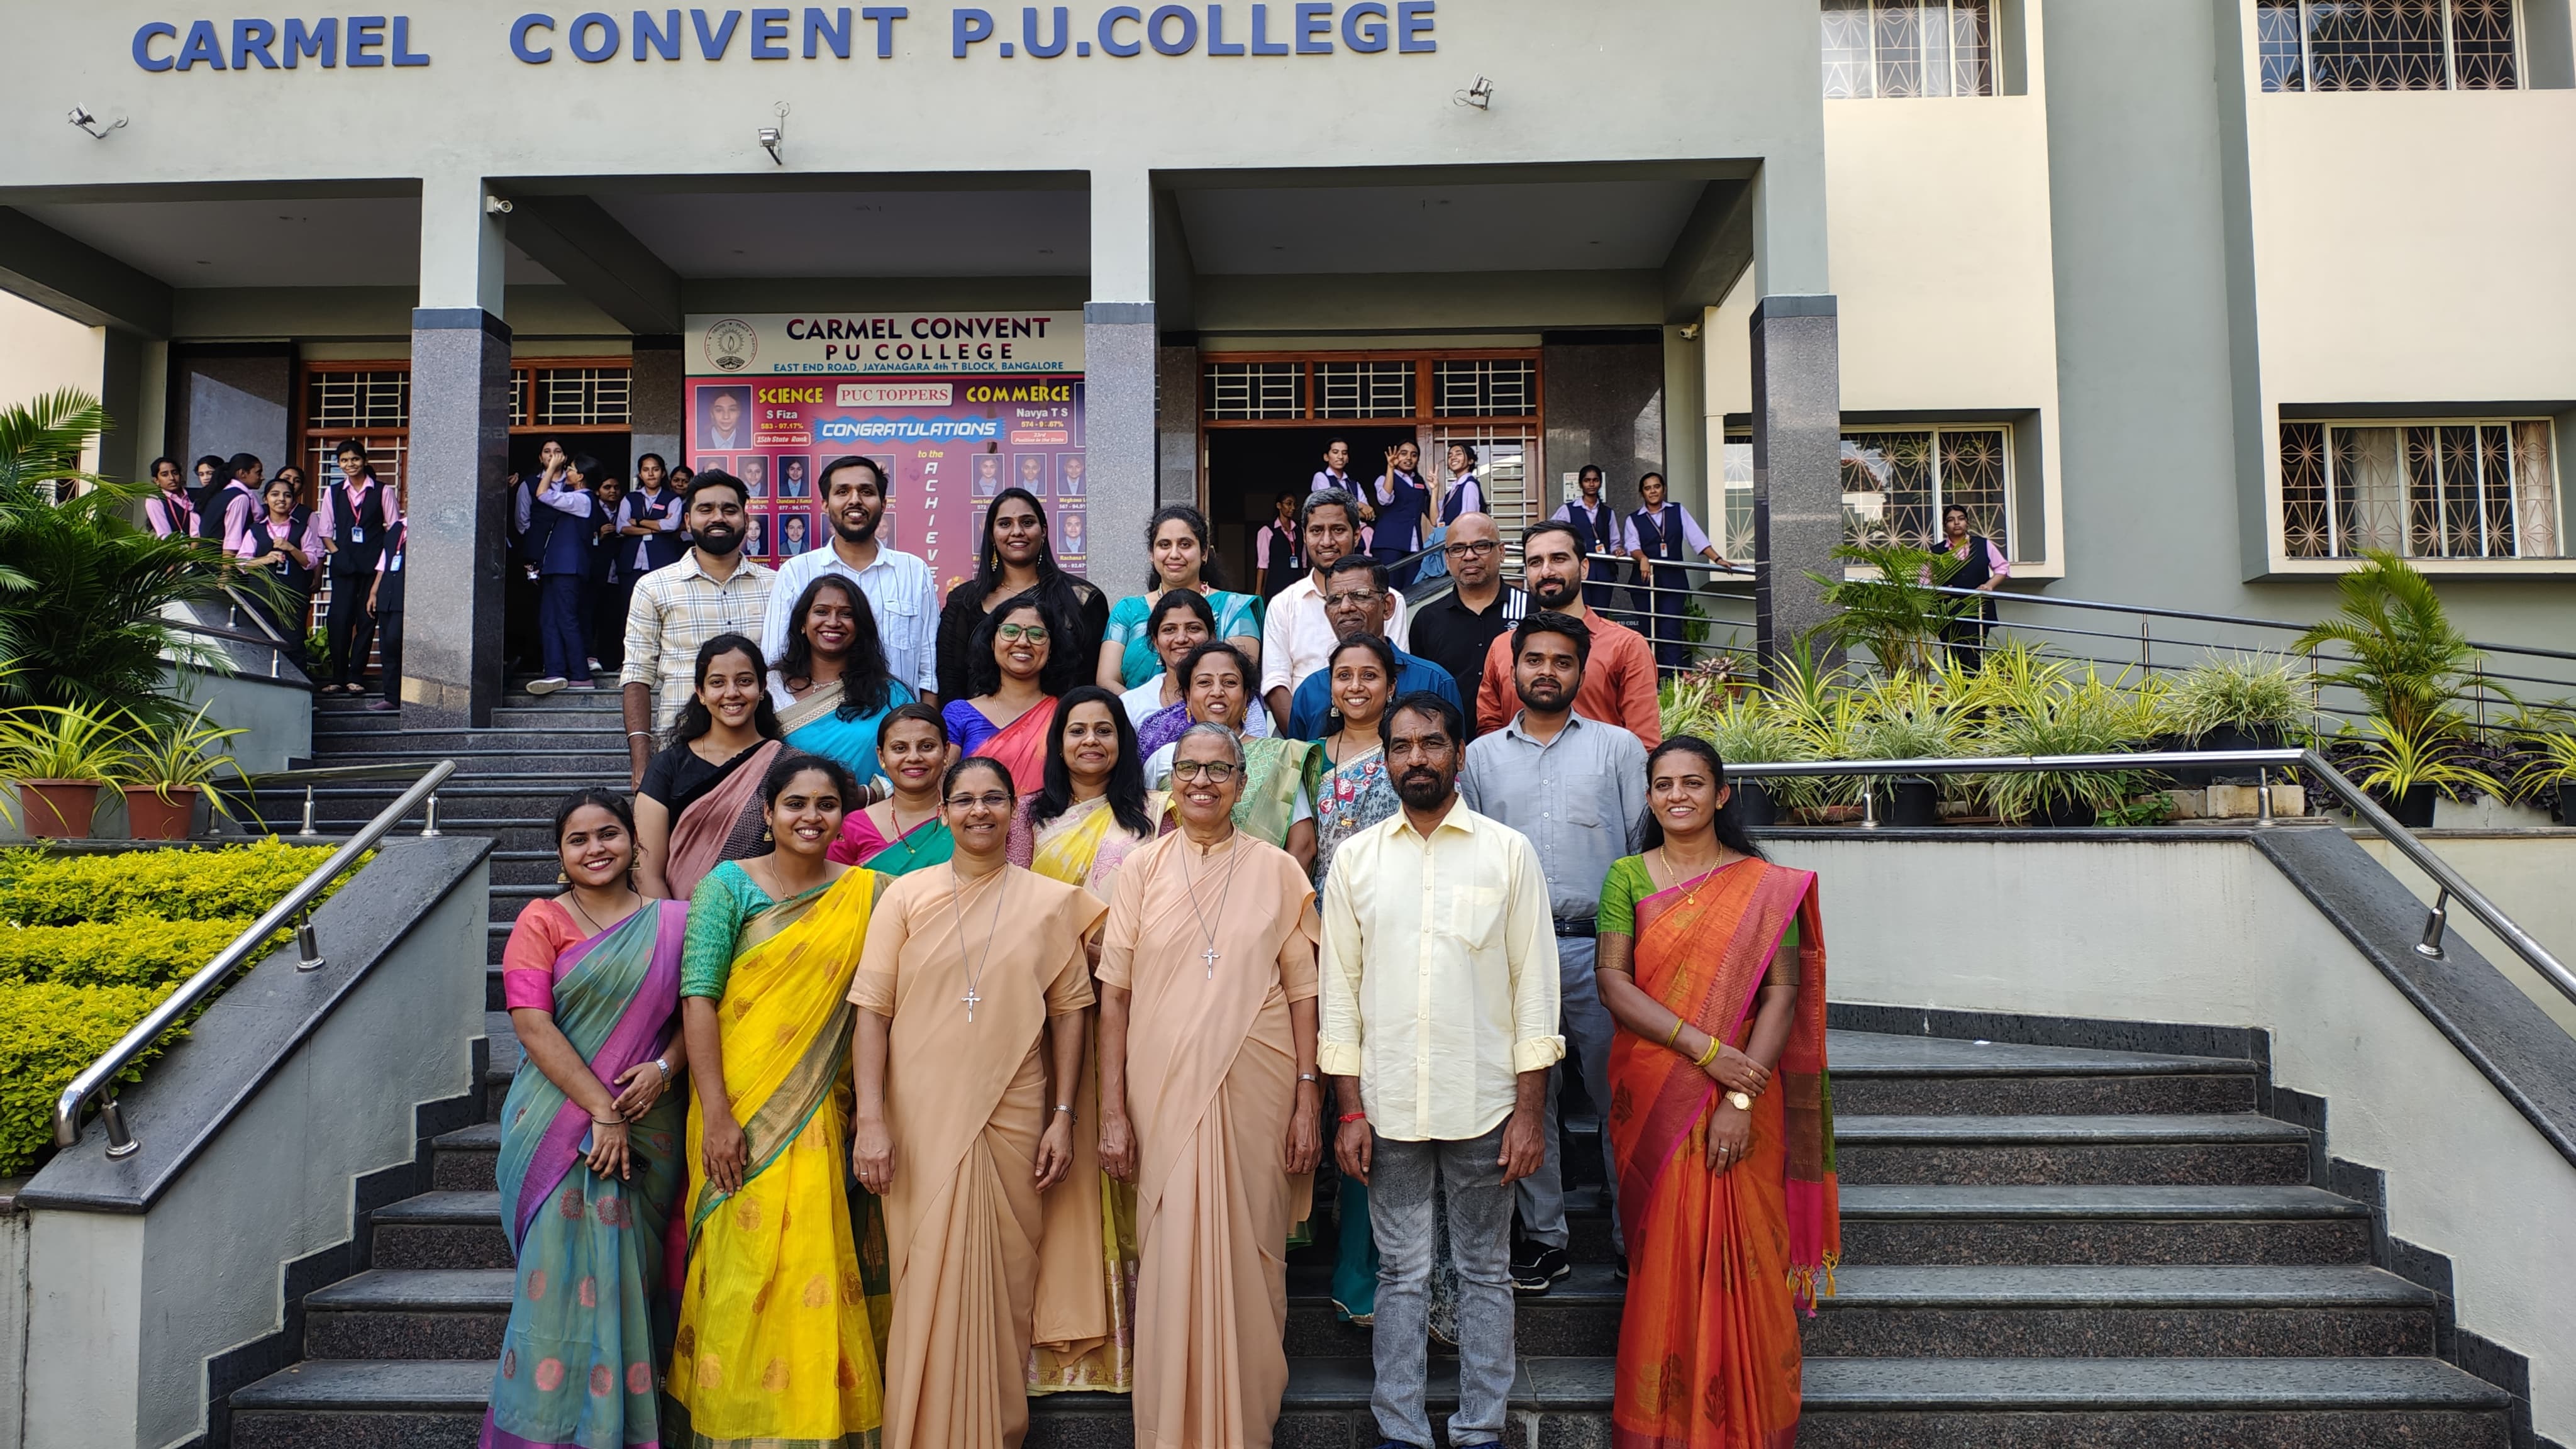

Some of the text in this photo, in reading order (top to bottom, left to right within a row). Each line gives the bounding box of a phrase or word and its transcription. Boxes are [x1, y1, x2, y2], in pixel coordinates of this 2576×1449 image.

[132, 1, 1437, 71] CARMEL CONVENT P.U.COLLEGE
[787, 318, 1051, 340] CARMEL CONVENT
[875, 343, 1012, 360] COLLEGE
[802, 364, 824, 372] END
[828, 363, 860, 372] ROAD,
[863, 362, 930, 372] JAYANAGARA
[933, 363, 948, 371] 4th
[952, 362, 958, 370] T
[962, 362, 998, 372] BLOCK,
[1002, 362, 1063, 370] BANGALORE
[758, 387, 823, 404] SCIENCE
[841, 389, 948, 401] PUC TOPPERS
[967, 386, 1070, 402] COMMERCE
[767, 410, 797, 419] S Fiza
[1016, 408, 1068, 419] Navya T S
[822, 423, 997, 437] CONGRATULATIONS
